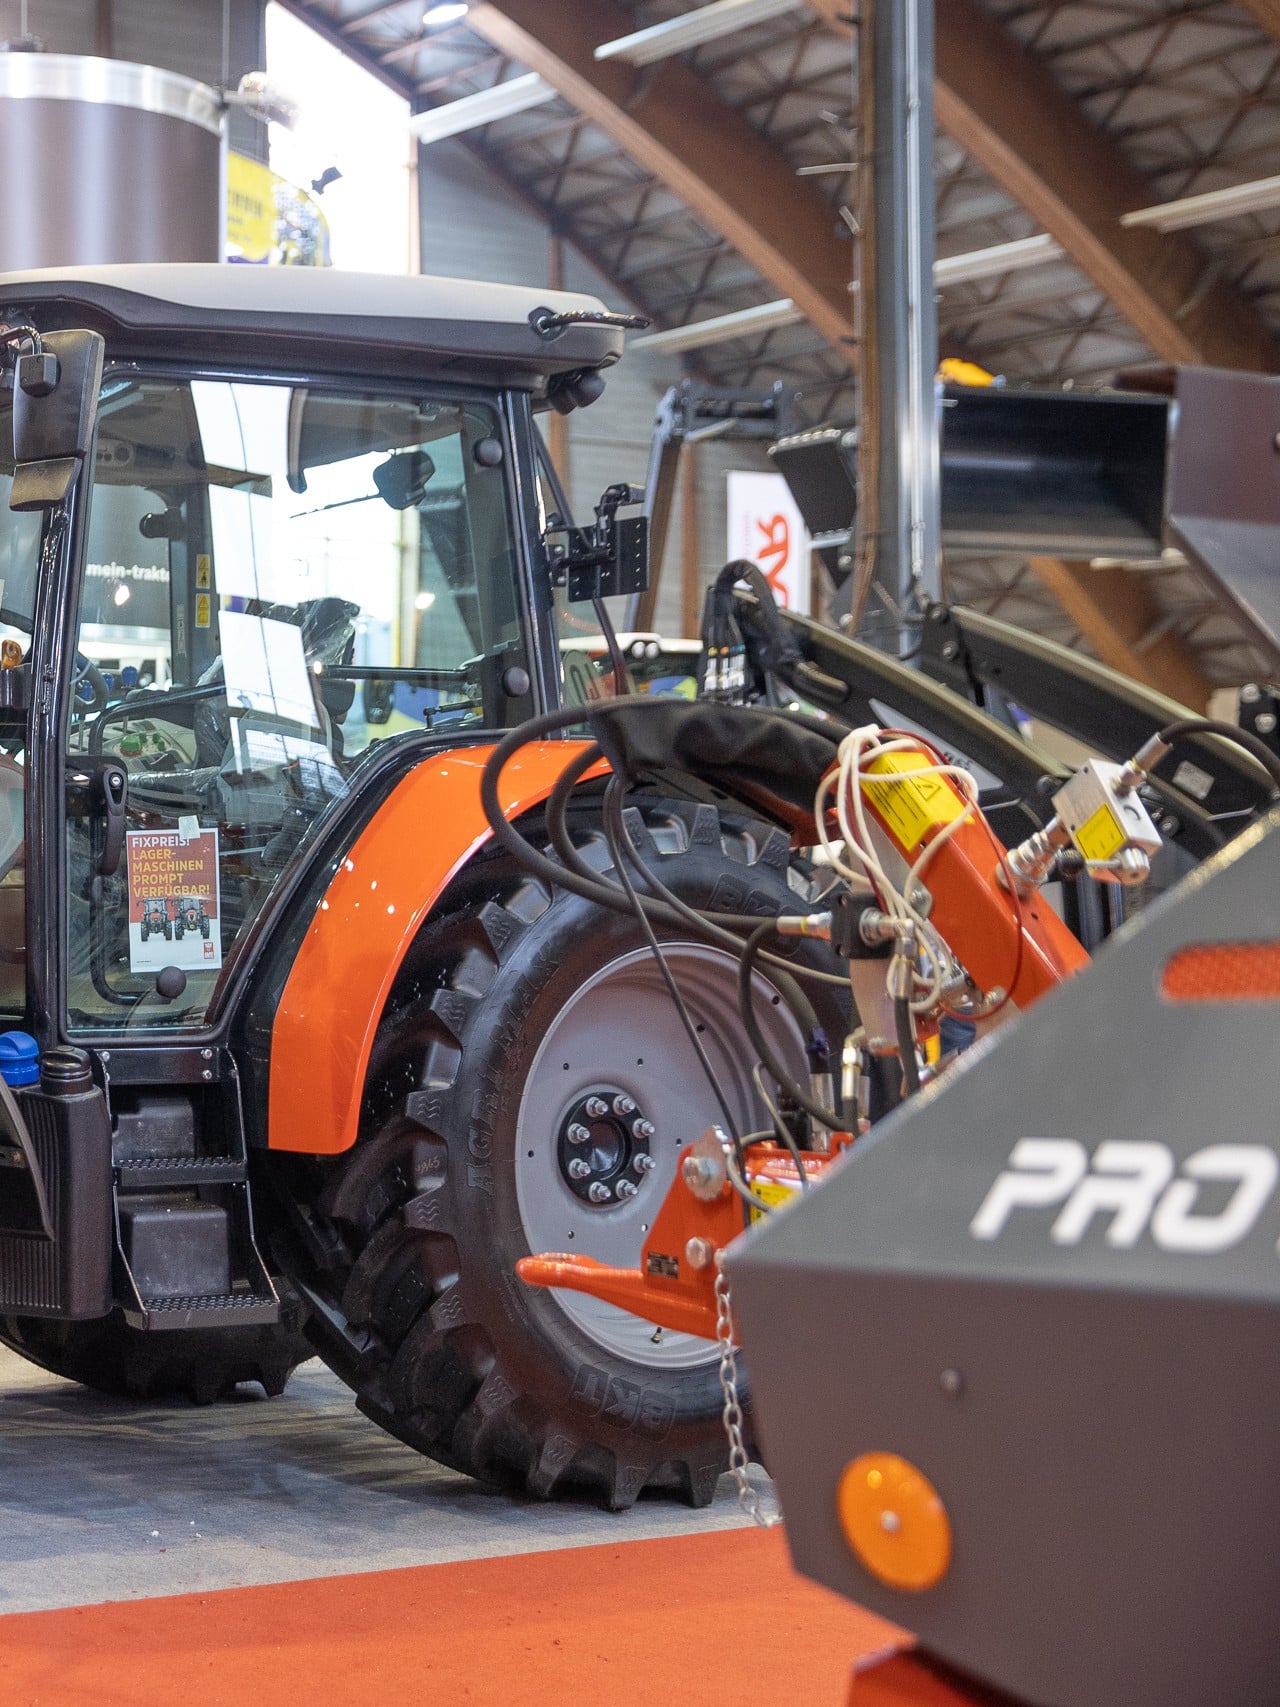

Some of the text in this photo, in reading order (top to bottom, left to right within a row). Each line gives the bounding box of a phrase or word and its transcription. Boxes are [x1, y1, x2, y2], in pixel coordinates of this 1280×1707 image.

[132, 836, 190, 848] FIXPREIS!
[132, 849, 177, 860] LAGER-
[132, 860, 204, 873] MASCHINEN
[133, 873, 184, 885] PROMPT
[133, 884, 210, 898] VERFÜGBAR!
[970, 1136, 1280, 1255] PRO
